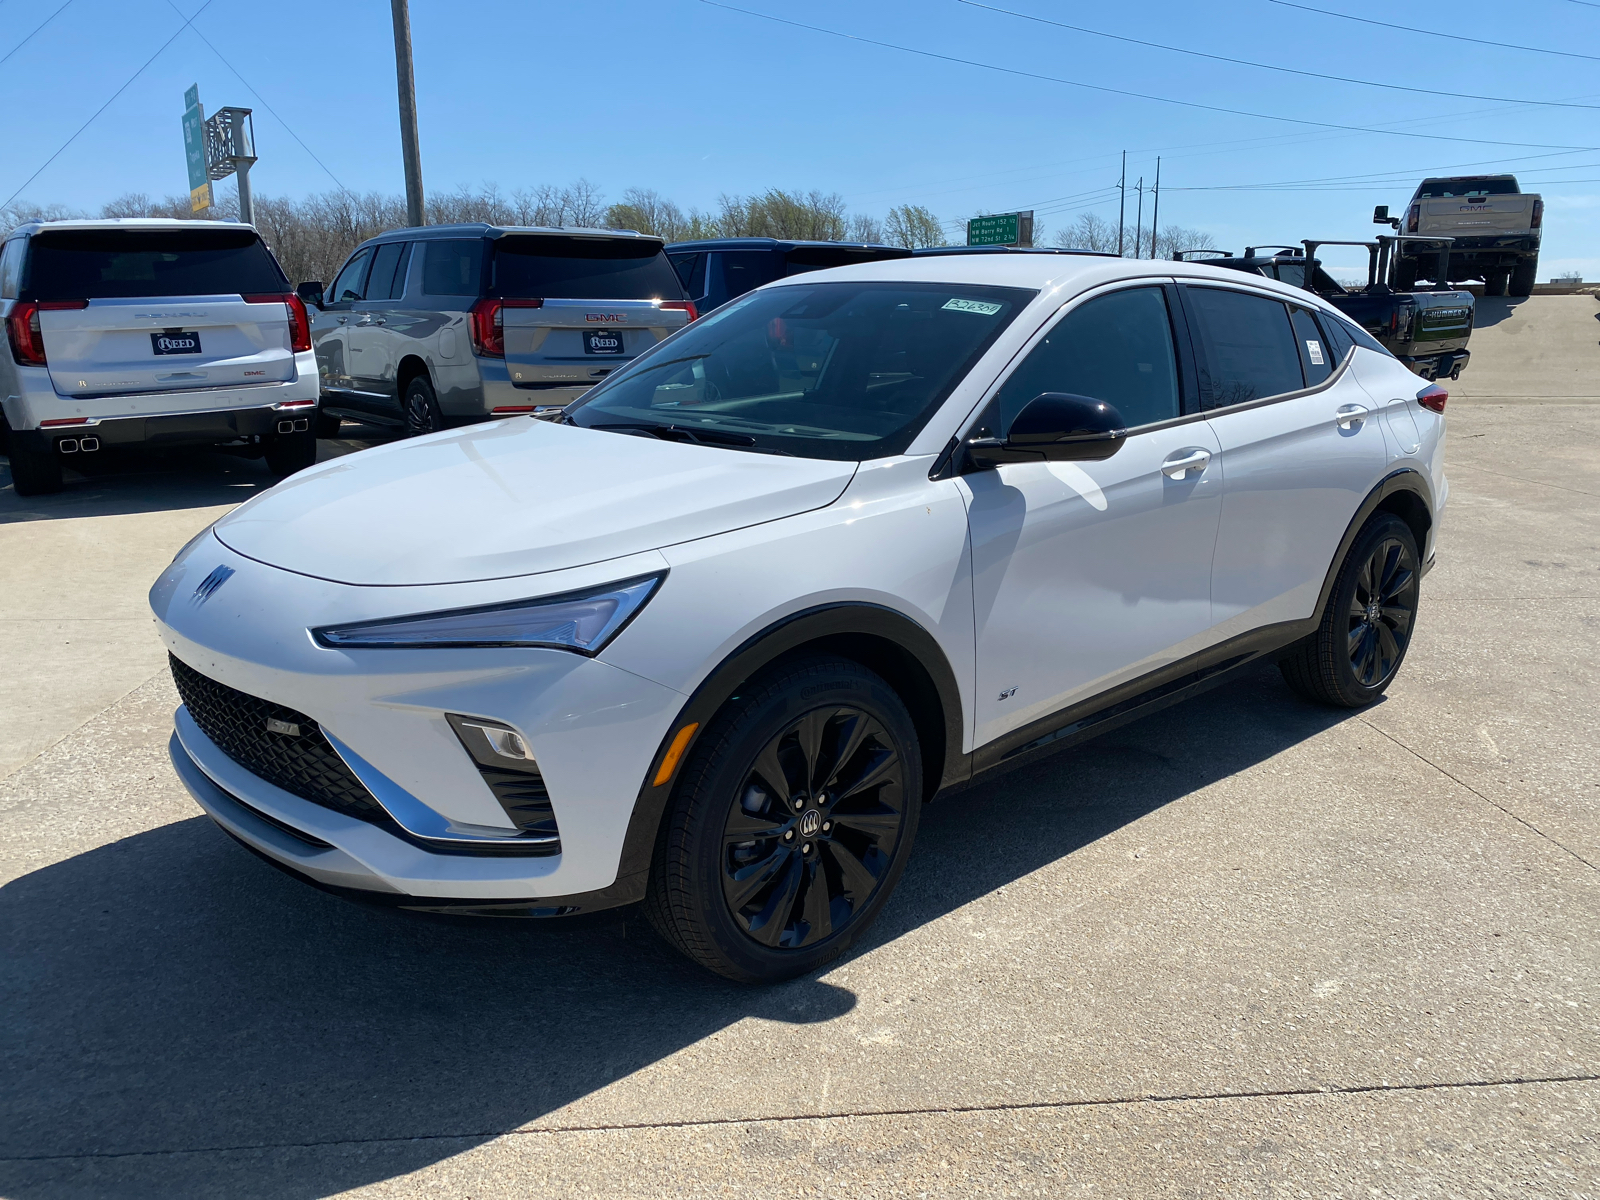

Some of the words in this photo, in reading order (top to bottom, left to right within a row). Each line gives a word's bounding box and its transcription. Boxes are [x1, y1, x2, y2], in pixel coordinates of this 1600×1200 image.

[585, 313, 628, 323] GMC
[1431, 309, 1462, 319] HUMMER
[157, 337, 195, 351] REED
[590, 336, 618, 349] REED
